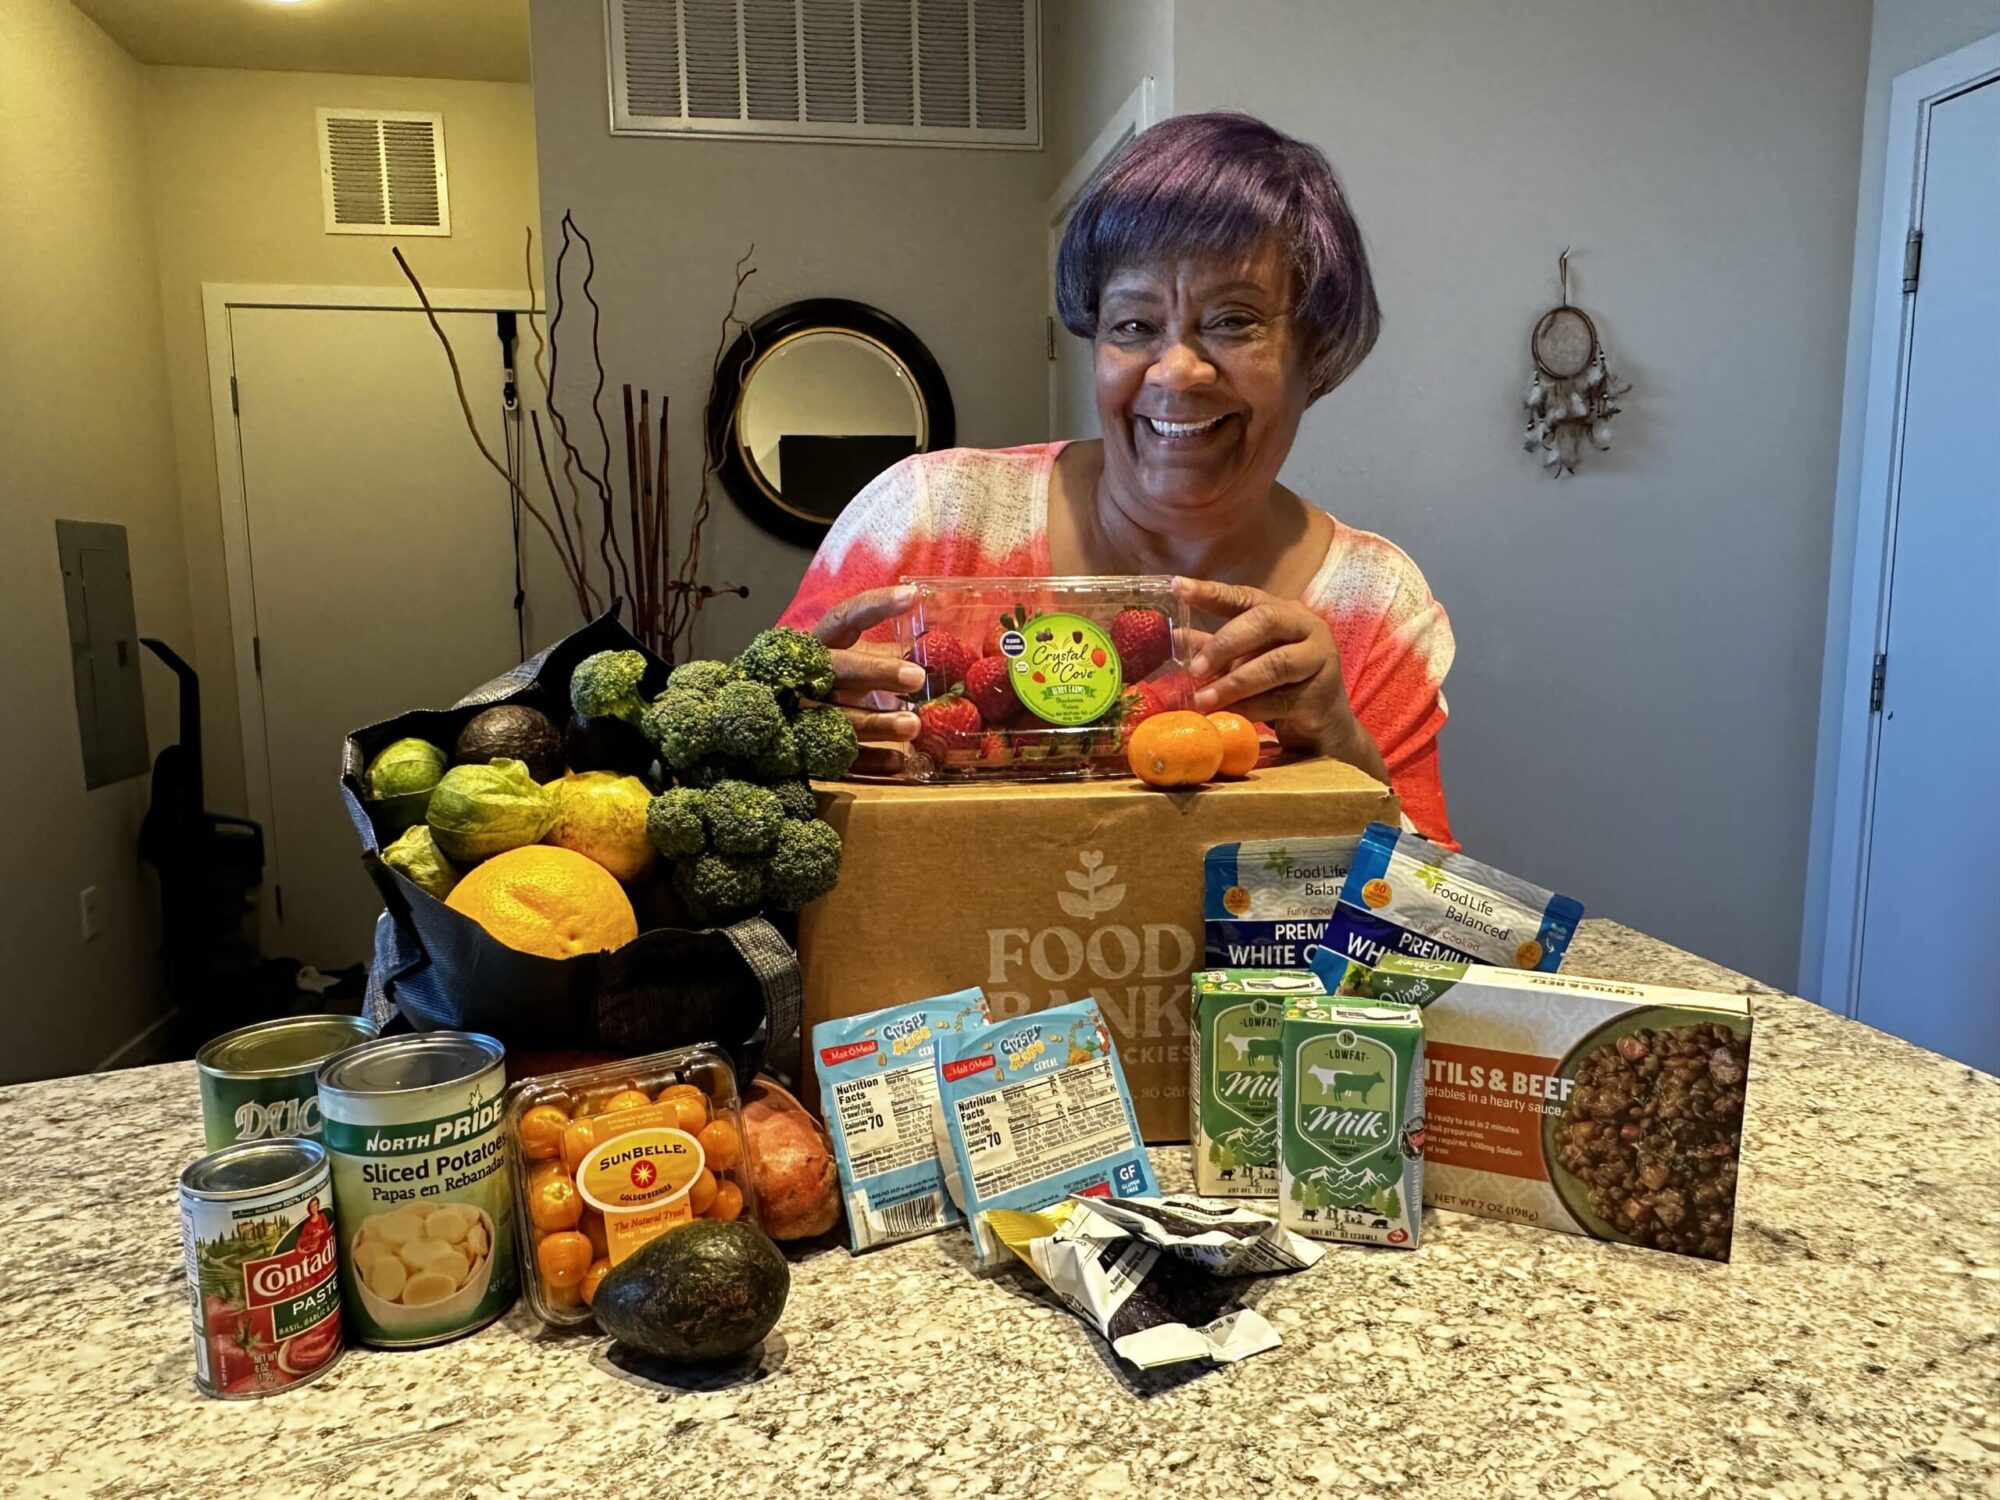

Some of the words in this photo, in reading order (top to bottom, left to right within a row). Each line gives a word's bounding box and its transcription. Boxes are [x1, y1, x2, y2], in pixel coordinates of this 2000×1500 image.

[1033, 644, 1088, 673] Crystal
[1060, 663, 1093, 683] Cove
[1286, 865, 1320, 878] Food
[1323, 864, 1347, 878] Life
[1373, 882, 1387, 893] 80
[1433, 883, 1469, 905] Food
[1469, 895, 1493, 916] Life
[1287, 907, 1307, 916] Fully
[1275, 923, 1329, 941] PREM
[1445, 905, 1510, 941] Balanced
[1419, 921, 1441, 937] Fully
[1442, 930, 1481, 952] Cooked
[986, 924, 1196, 985] FOOD
[1228, 944, 1296, 966] WHITE
[1398, 932, 1474, 964] PREMIU
[988, 984, 1191, 1040] BNK
[882, 1011, 928, 1041] Crispy
[999, 1024, 1042, 1055] Crispy
[1034, 1057, 1059, 1072] CEREAL
[836, 1078, 879, 1096] Nutrition
[1488, 1068, 1507, 1092] &
[1512, 1072, 1576, 1101] BEEF
[838, 1092, 866, 1105] Facts
[841, 1103, 861, 1113] Serving
[958, 1095, 997, 1112] Nutrition
[1468, 1090, 1478, 1103] in
[1480, 1095, 1487, 1104] a
[1490, 1095, 1525, 1113] hearty
[235, 1095, 322, 1140] DUC
[845, 1119, 868, 1131] Calories
[868, 1114, 884, 1130] 70
[847, 1109, 860, 1119] bowl
[960, 1108, 985, 1122] Facts
[1308, 1106, 1383, 1138] Milk
[1434, 1114, 1454, 1124] ready
[1464, 1119, 1475, 1127] eat
[1485, 1121, 1490, 1129] 2
[1491, 1123, 1520, 1134] minutes
[366, 1129, 431, 1152] NORTH
[433, 1098, 503, 1146] PRIDE
[963, 1121, 980, 1130] Serving
[969, 1128, 980, 1136] bowl
[1443, 1127, 1484, 1139] preparation
[967, 1137, 987, 1148] Calories
[987, 1131, 1001, 1147] 70
[362, 1159, 430, 1184] Sliced
[436, 1132, 507, 1177] Potatoes
[600, 1144, 683, 1172] SUNBELLE
[372, 1187, 416, 1204] Papas
[420, 1184, 441, 1198] en
[445, 1155, 505, 1193] Rebanadas
[1120, 1165, 1136, 1181] GF
[1434, 1193, 1456, 1204] NET
[1459, 1198, 1476, 1208] WT
[1479, 1201, 1485, 1209] 7
[1487, 1203, 1503, 1213] OZ
[614, 1222, 629, 1232] The
[631, 1212, 662, 1228] Natural
[293, 1276, 338, 1316] PASTE
